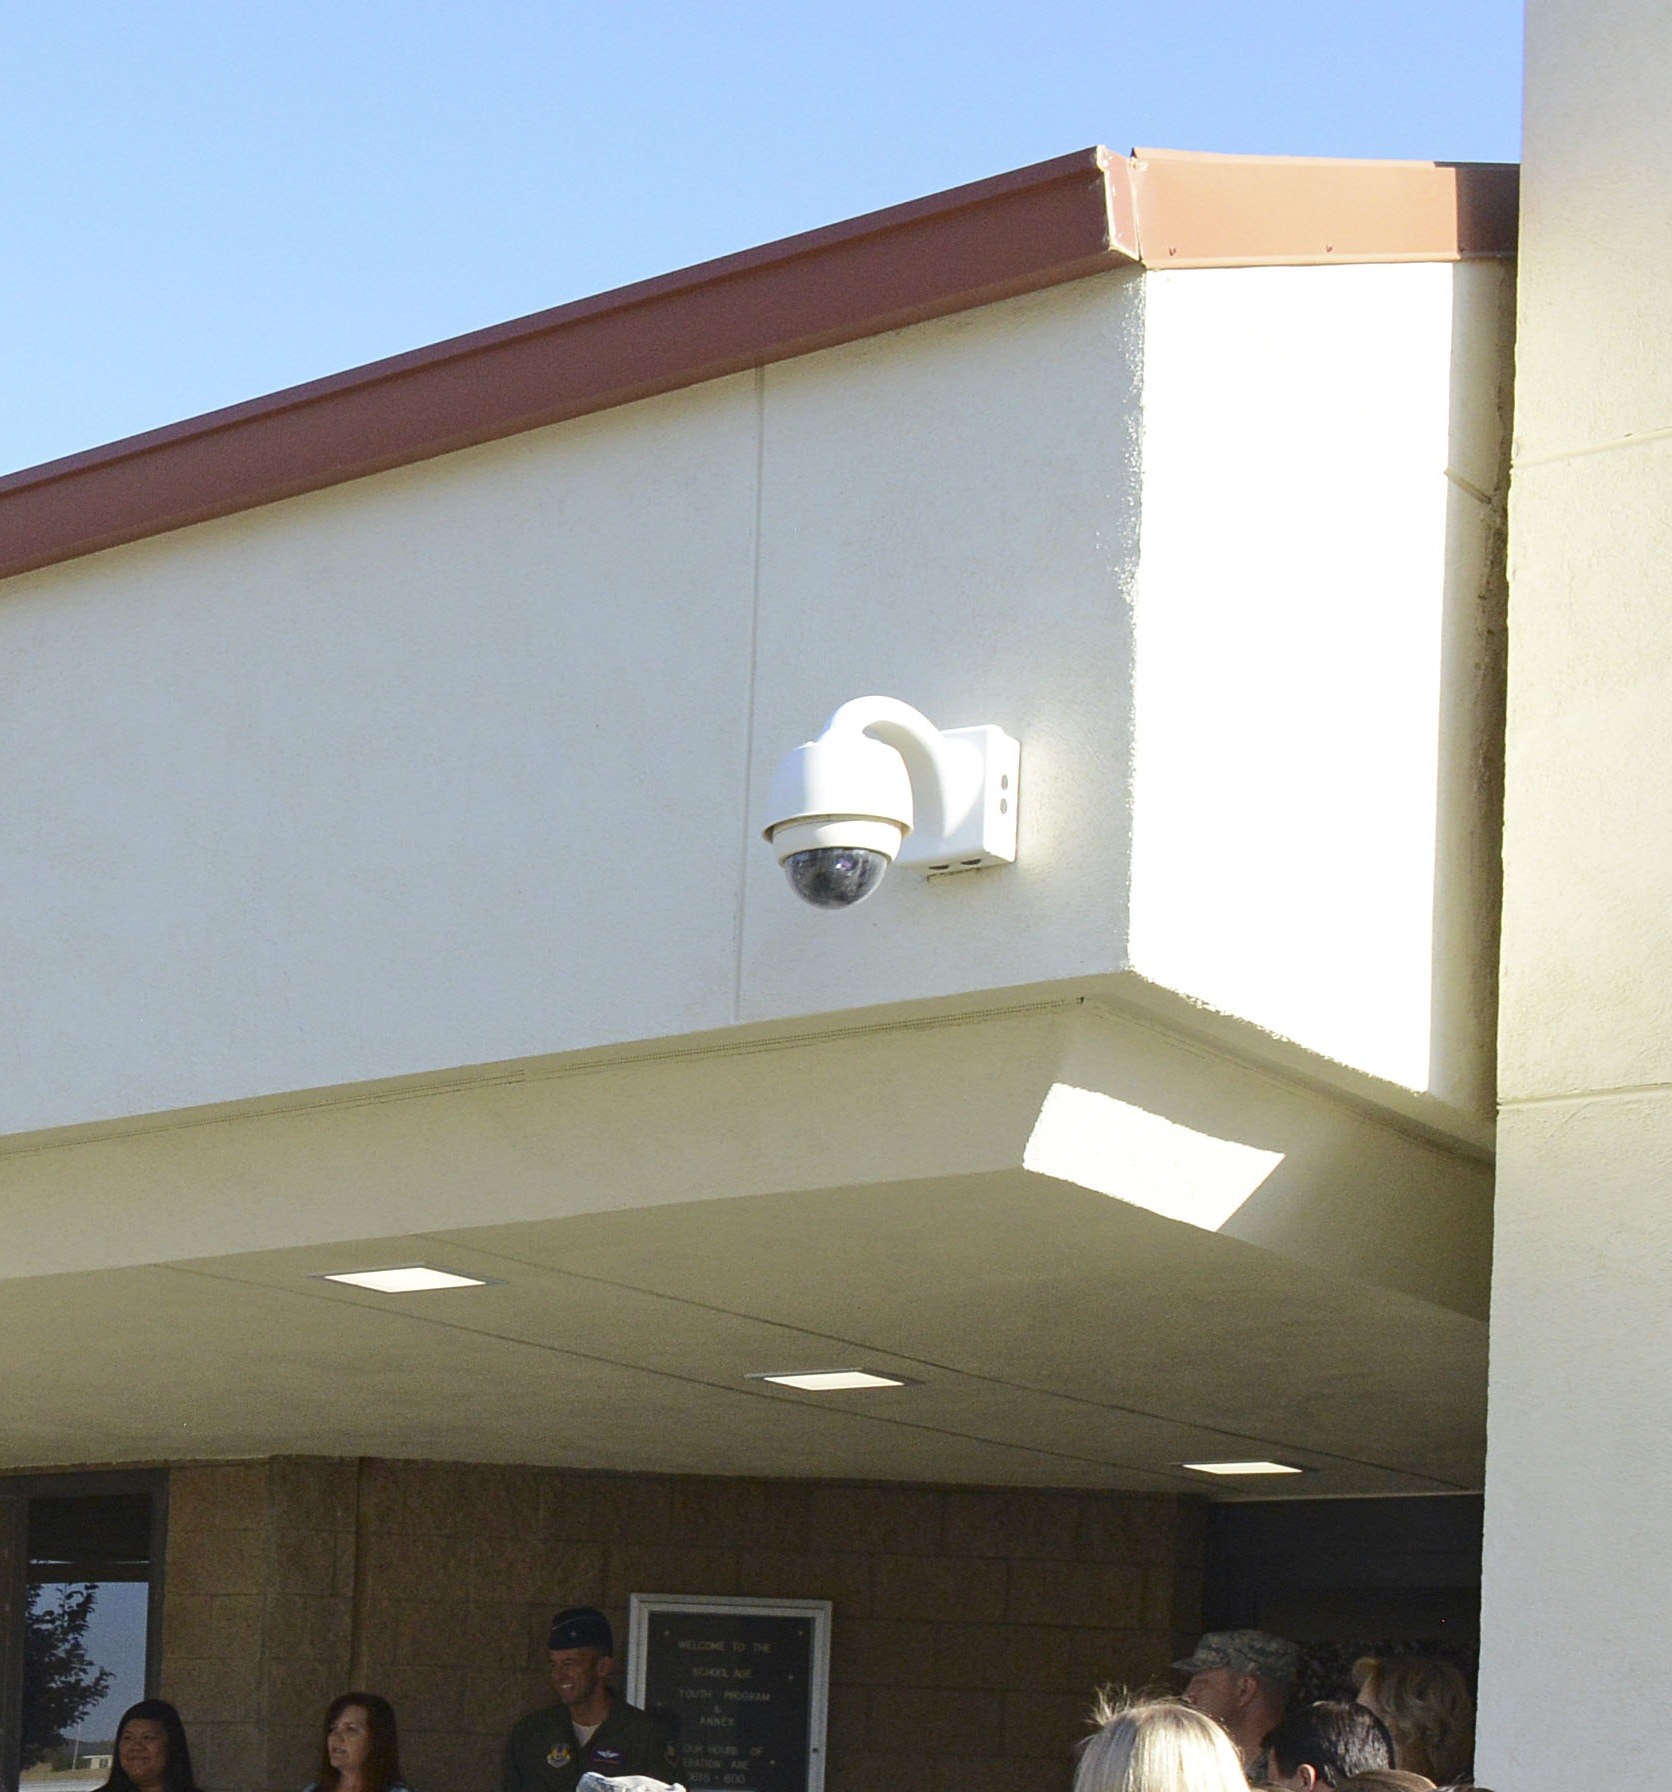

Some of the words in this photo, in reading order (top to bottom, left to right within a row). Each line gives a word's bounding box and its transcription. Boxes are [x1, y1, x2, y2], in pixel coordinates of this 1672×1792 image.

[678, 1640, 726, 1652] WELCOME
[732, 1641, 746, 1653] TO
[752, 1642, 771, 1654] THE
[692, 1667, 729, 1679] SCHOOL
[678, 1689, 712, 1700] YOUTH
[723, 1690, 771, 1702] PROGRAM
[699, 1716, 735, 1727] ANNEX
[749, 1746, 764, 1757] OF
[682, 1759, 721, 1770] ERATION
